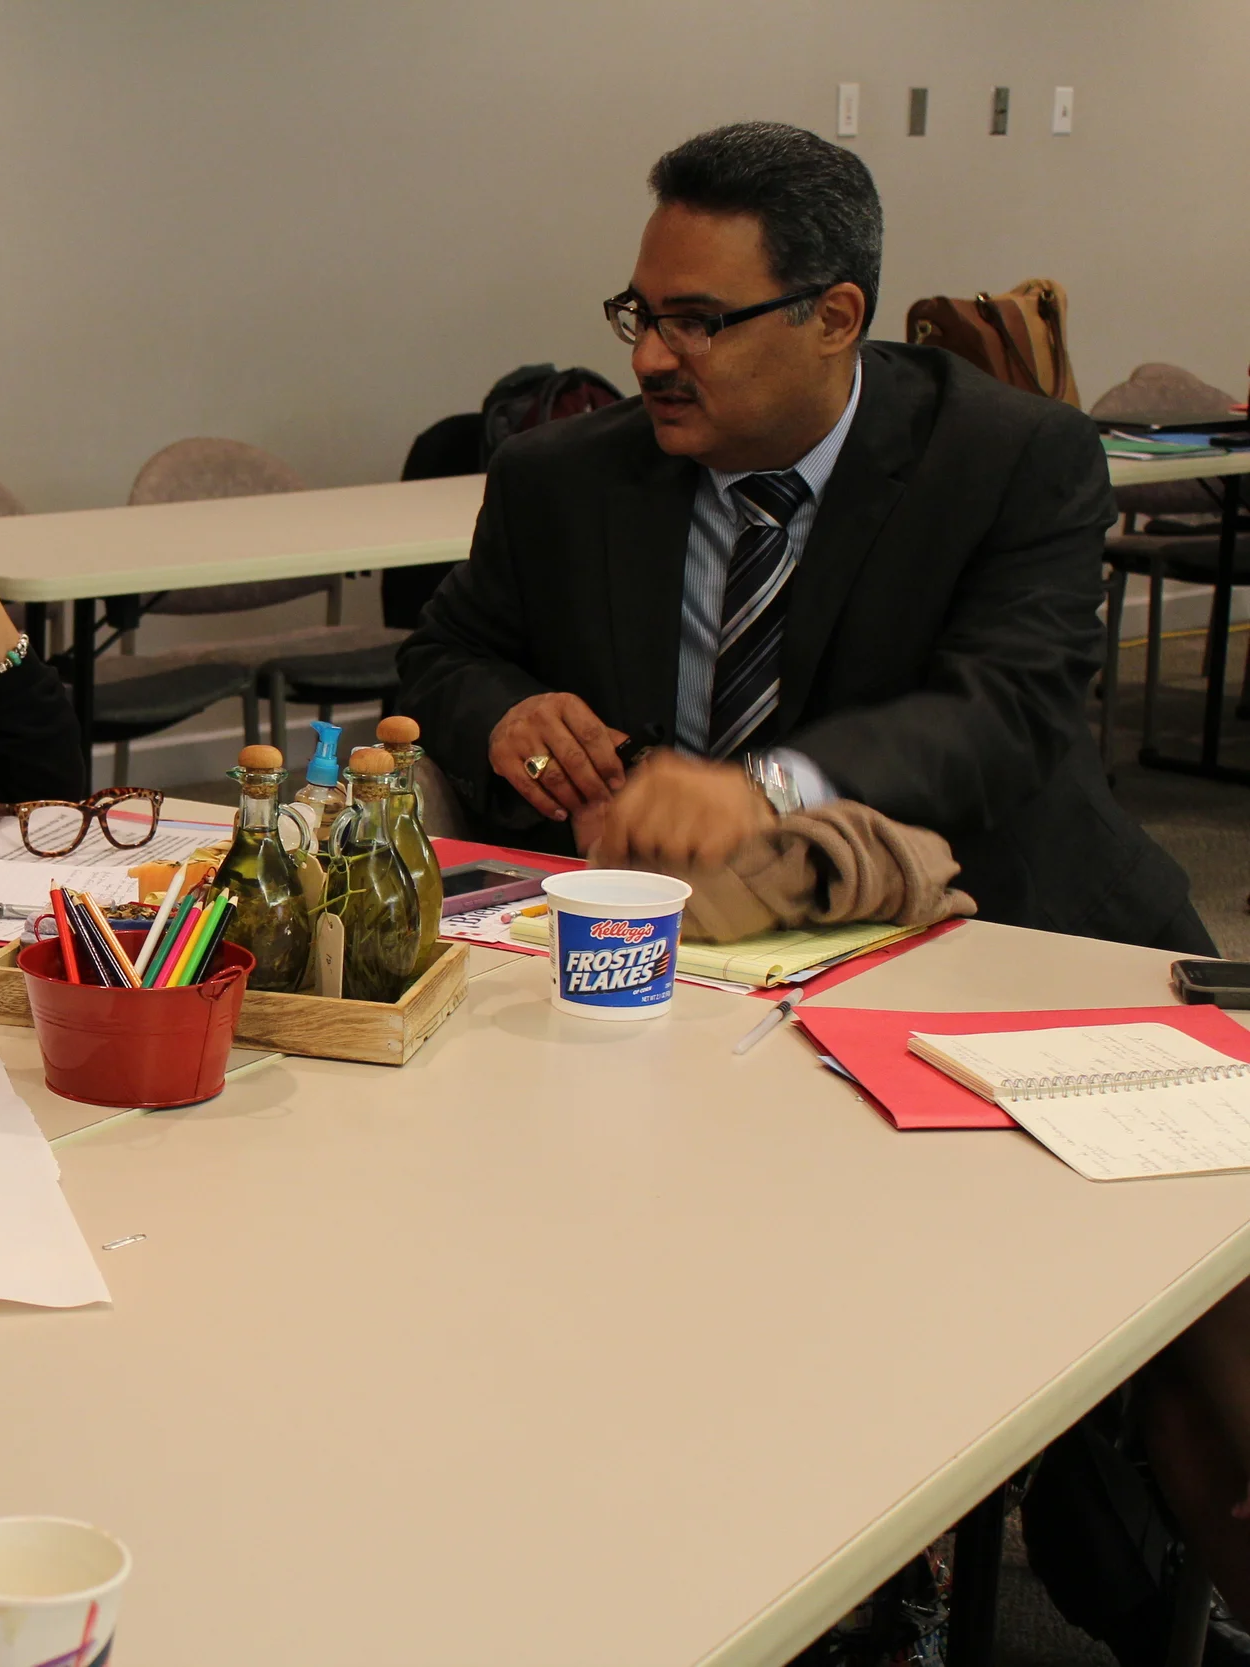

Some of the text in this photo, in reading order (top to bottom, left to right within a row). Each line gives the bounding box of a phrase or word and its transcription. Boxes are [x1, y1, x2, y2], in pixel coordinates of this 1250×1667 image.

[590, 920, 654, 944] Kellogg's
[566, 938, 667, 972] FROSTED
[568, 962, 655, 992] FLAKES
